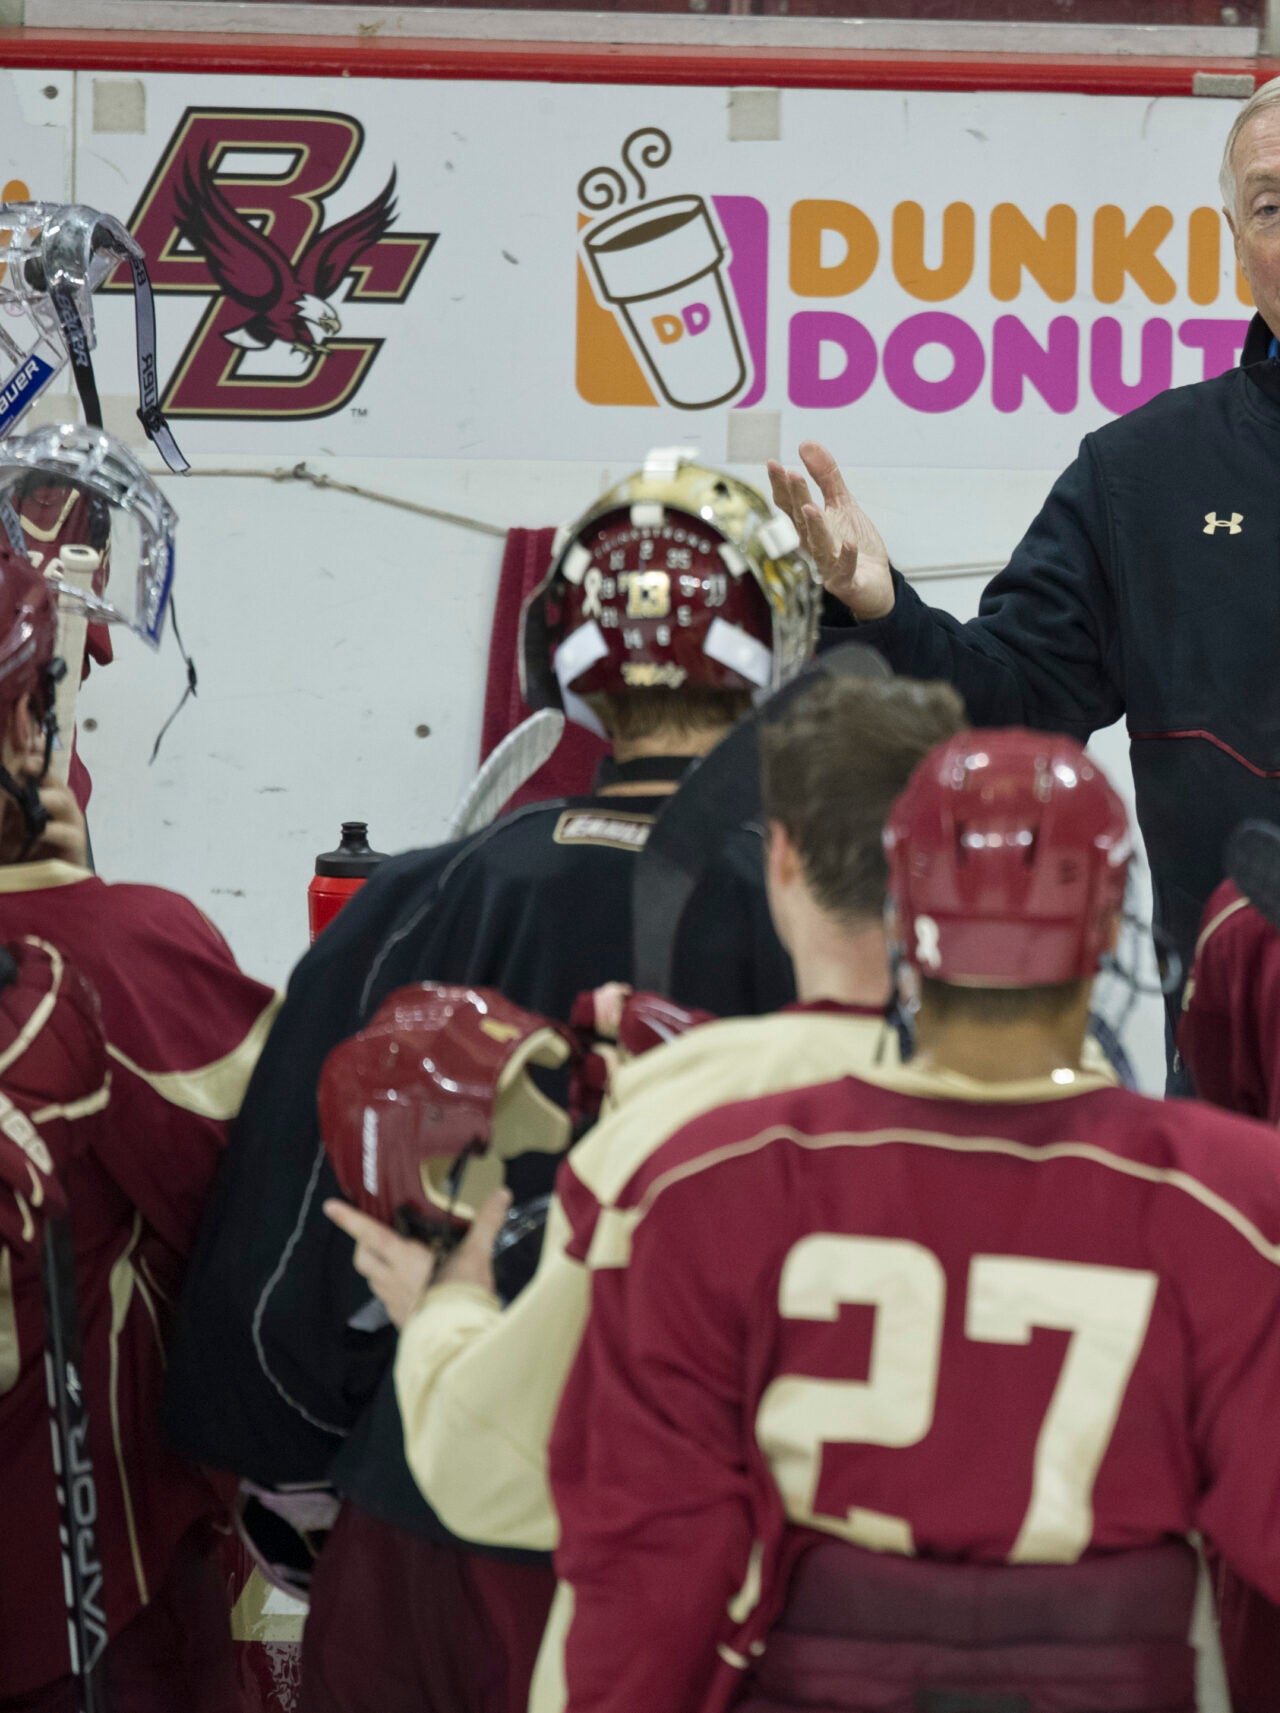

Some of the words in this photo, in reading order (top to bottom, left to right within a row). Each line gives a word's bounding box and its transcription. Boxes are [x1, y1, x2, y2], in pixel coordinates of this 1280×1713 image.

[789, 199, 1258, 307] DUNKI
[652, 303, 710, 344] DD
[788, 311, 1252, 415] DONUT
[0, 359, 40, 416] AUER
[350, 408, 369, 418] TM
[756, 1231, 1158, 1564] 27
[67, 1412, 109, 1675] VAPOR
